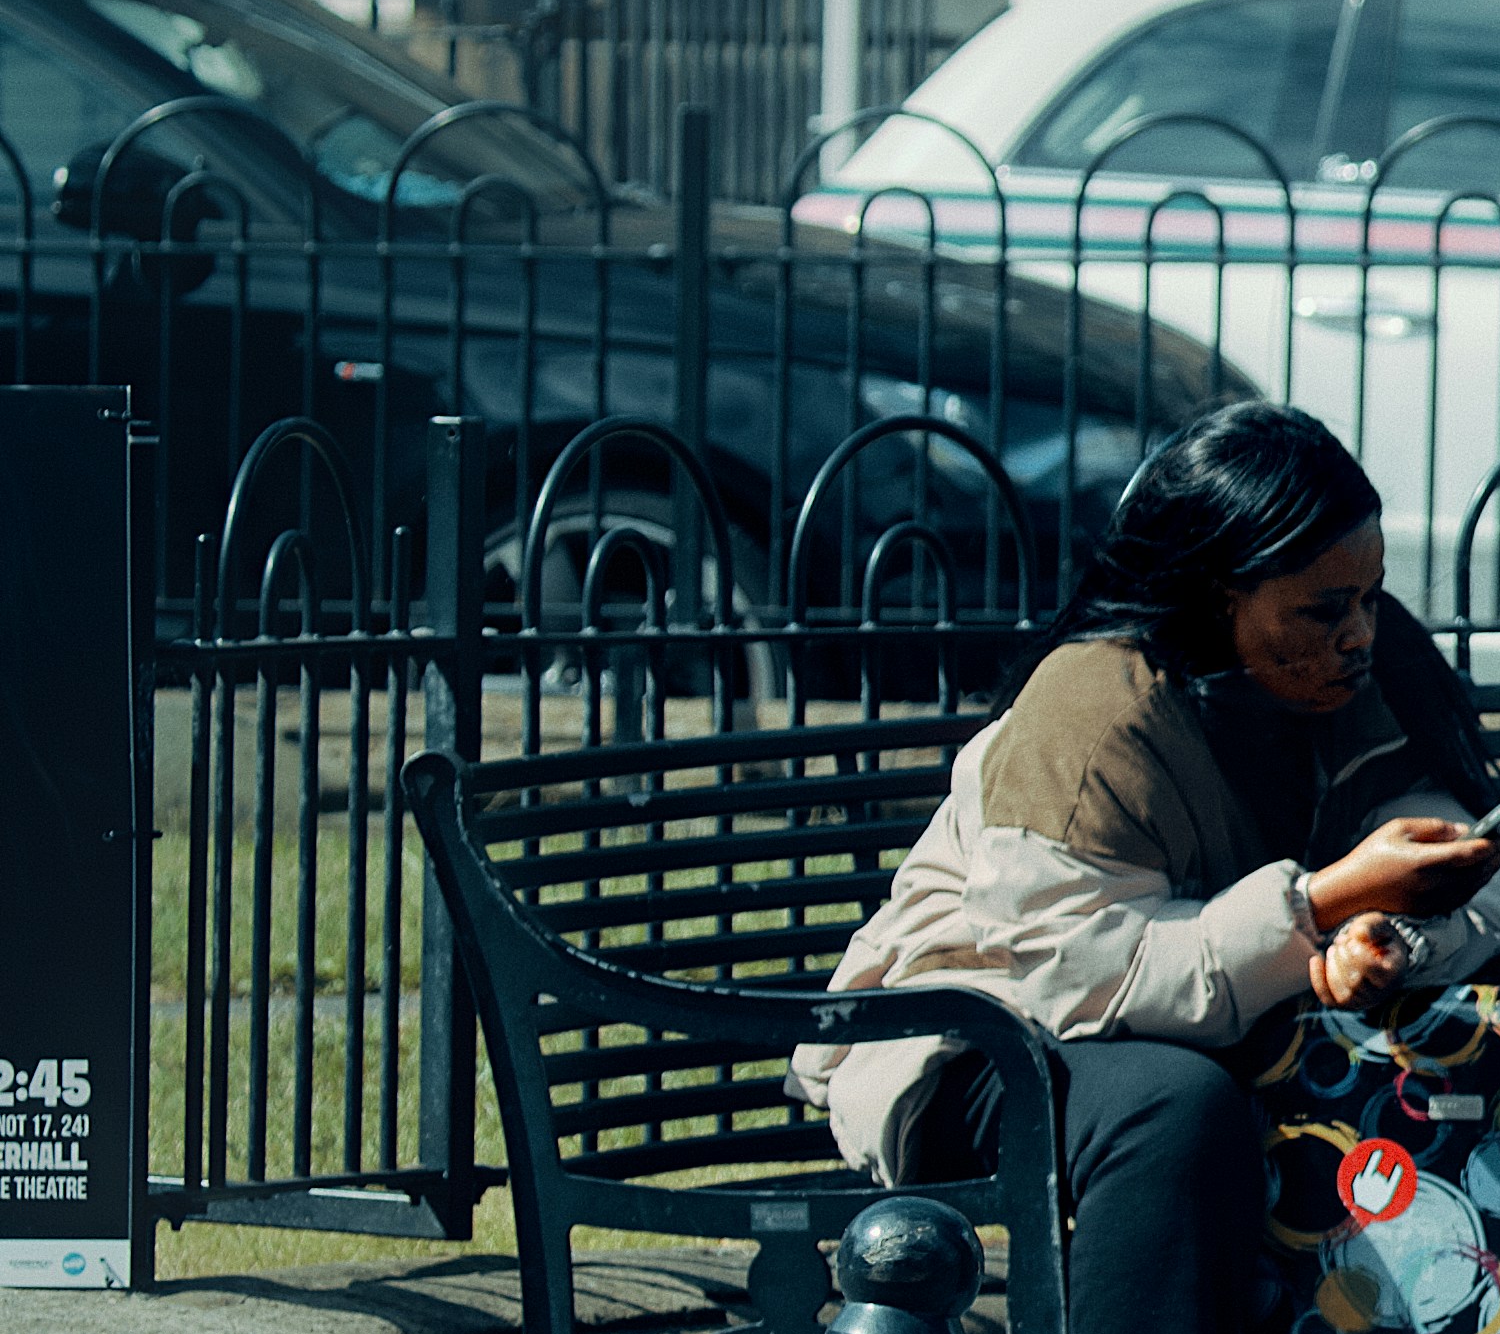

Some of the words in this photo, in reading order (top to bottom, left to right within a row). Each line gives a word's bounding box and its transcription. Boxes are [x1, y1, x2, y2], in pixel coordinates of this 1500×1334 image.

[32, 1114, 57, 1140] 17,
[61, 1114, 90, 1137] 24)
[14, 1175, 88, 1200] THEATRE
